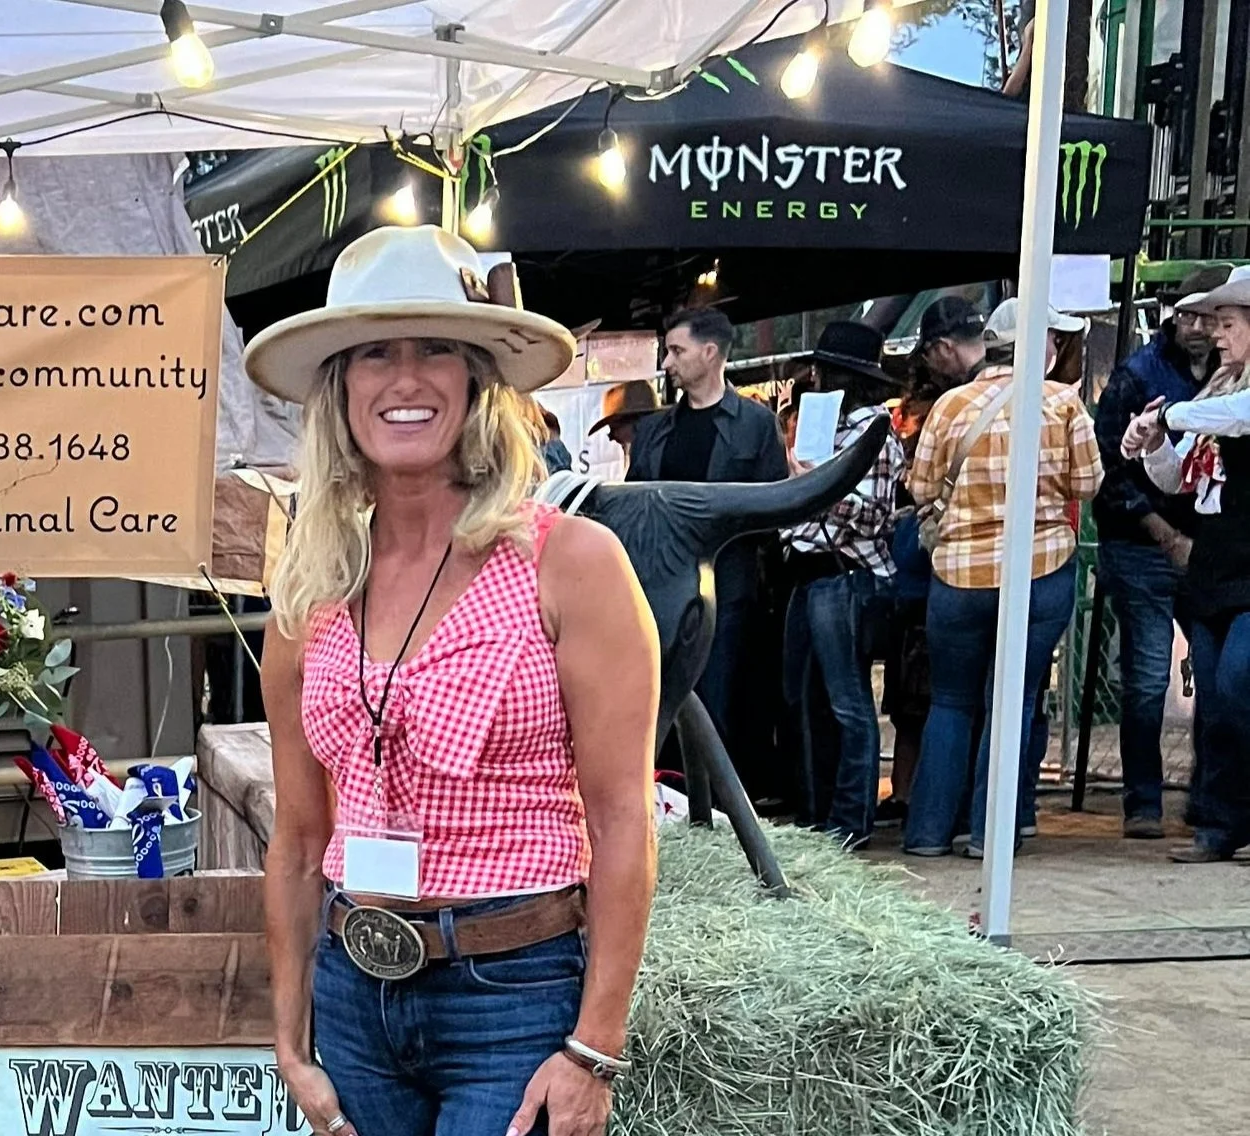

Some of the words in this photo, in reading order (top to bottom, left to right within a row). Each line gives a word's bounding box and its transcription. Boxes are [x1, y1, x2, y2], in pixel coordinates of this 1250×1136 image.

[649, 134, 907, 192] MONSTER
[691, 201, 867, 219] ENERGY
[89, 495, 178, 533] Care
